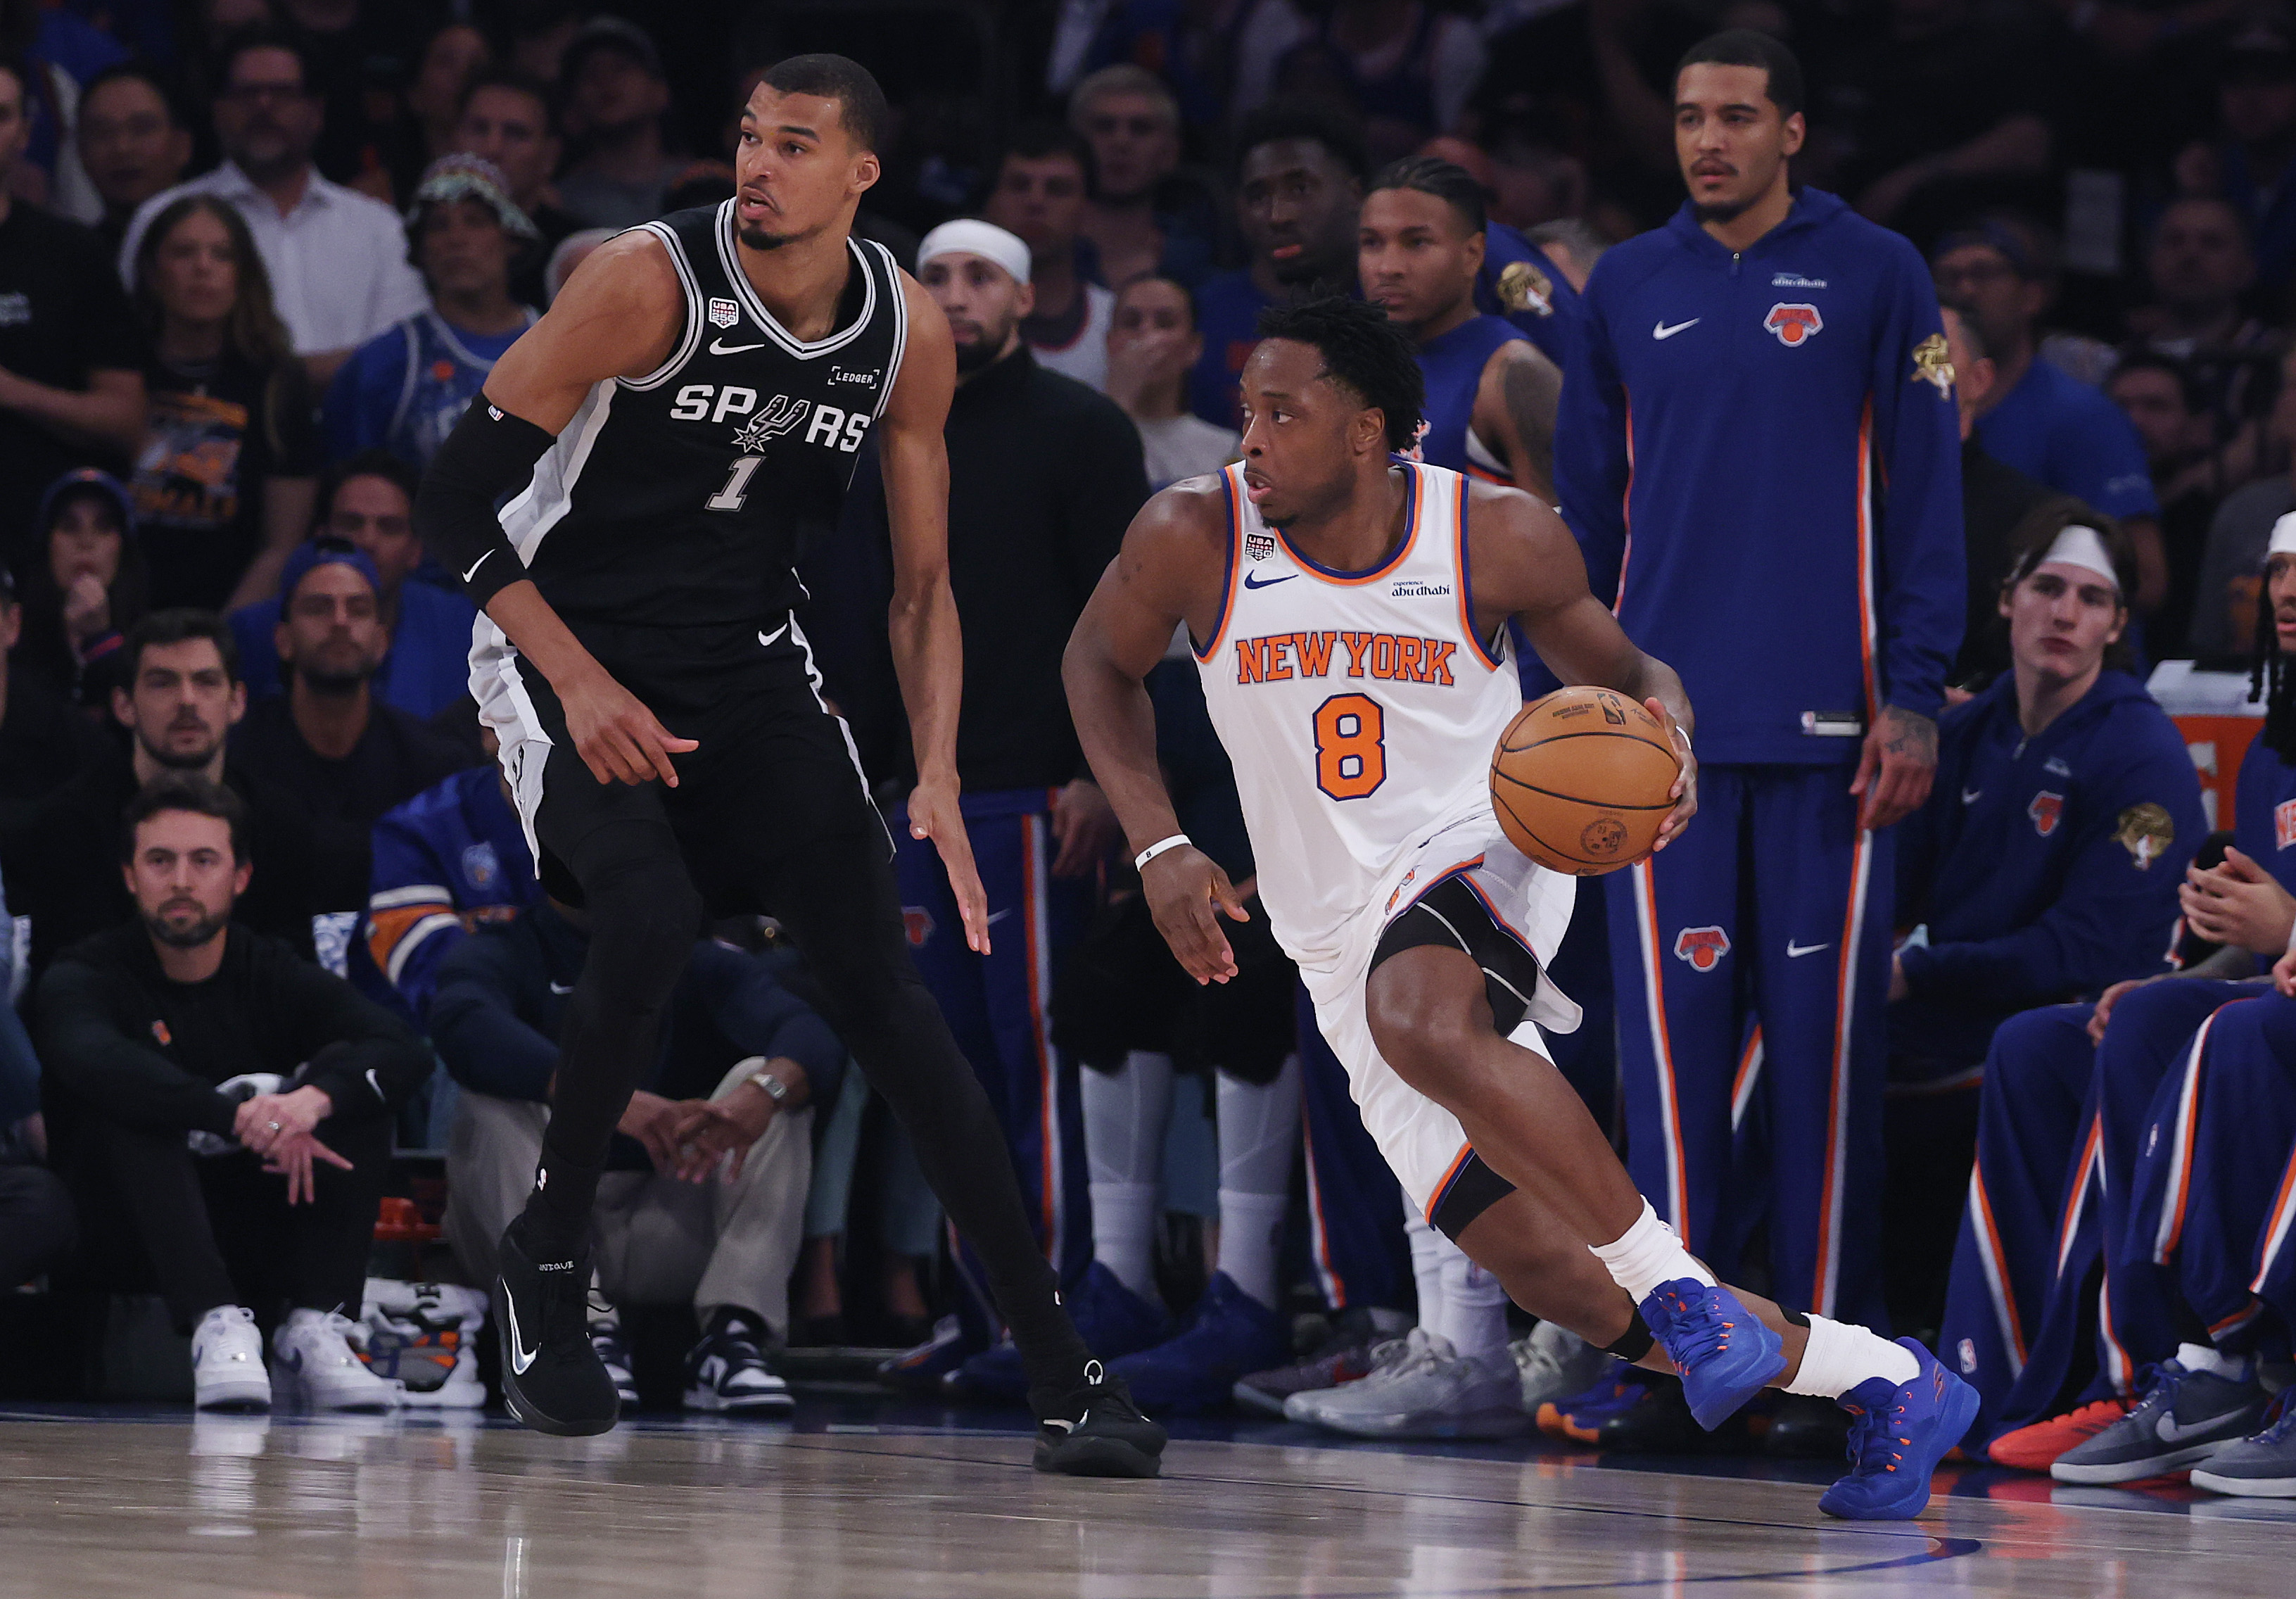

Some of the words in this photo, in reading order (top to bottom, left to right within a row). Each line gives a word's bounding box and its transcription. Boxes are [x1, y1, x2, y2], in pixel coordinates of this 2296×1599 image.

[713, 301, 735, 311] USA
[711, 312, 737, 323] 250
[835, 371, 874, 384] LEDGER
[670, 384, 873, 453] SPURS
[704, 455, 767, 512] 1
[1248, 536, 1273, 546] USA
[1245, 547, 1274, 558] 250
[1391, 586, 1414, 597] abu
[1416, 585, 1451, 596] dhabi
[1235, 630, 1336, 685] NEW
[1340, 630, 1457, 687] YORK
[1312, 692, 1387, 802] 8
